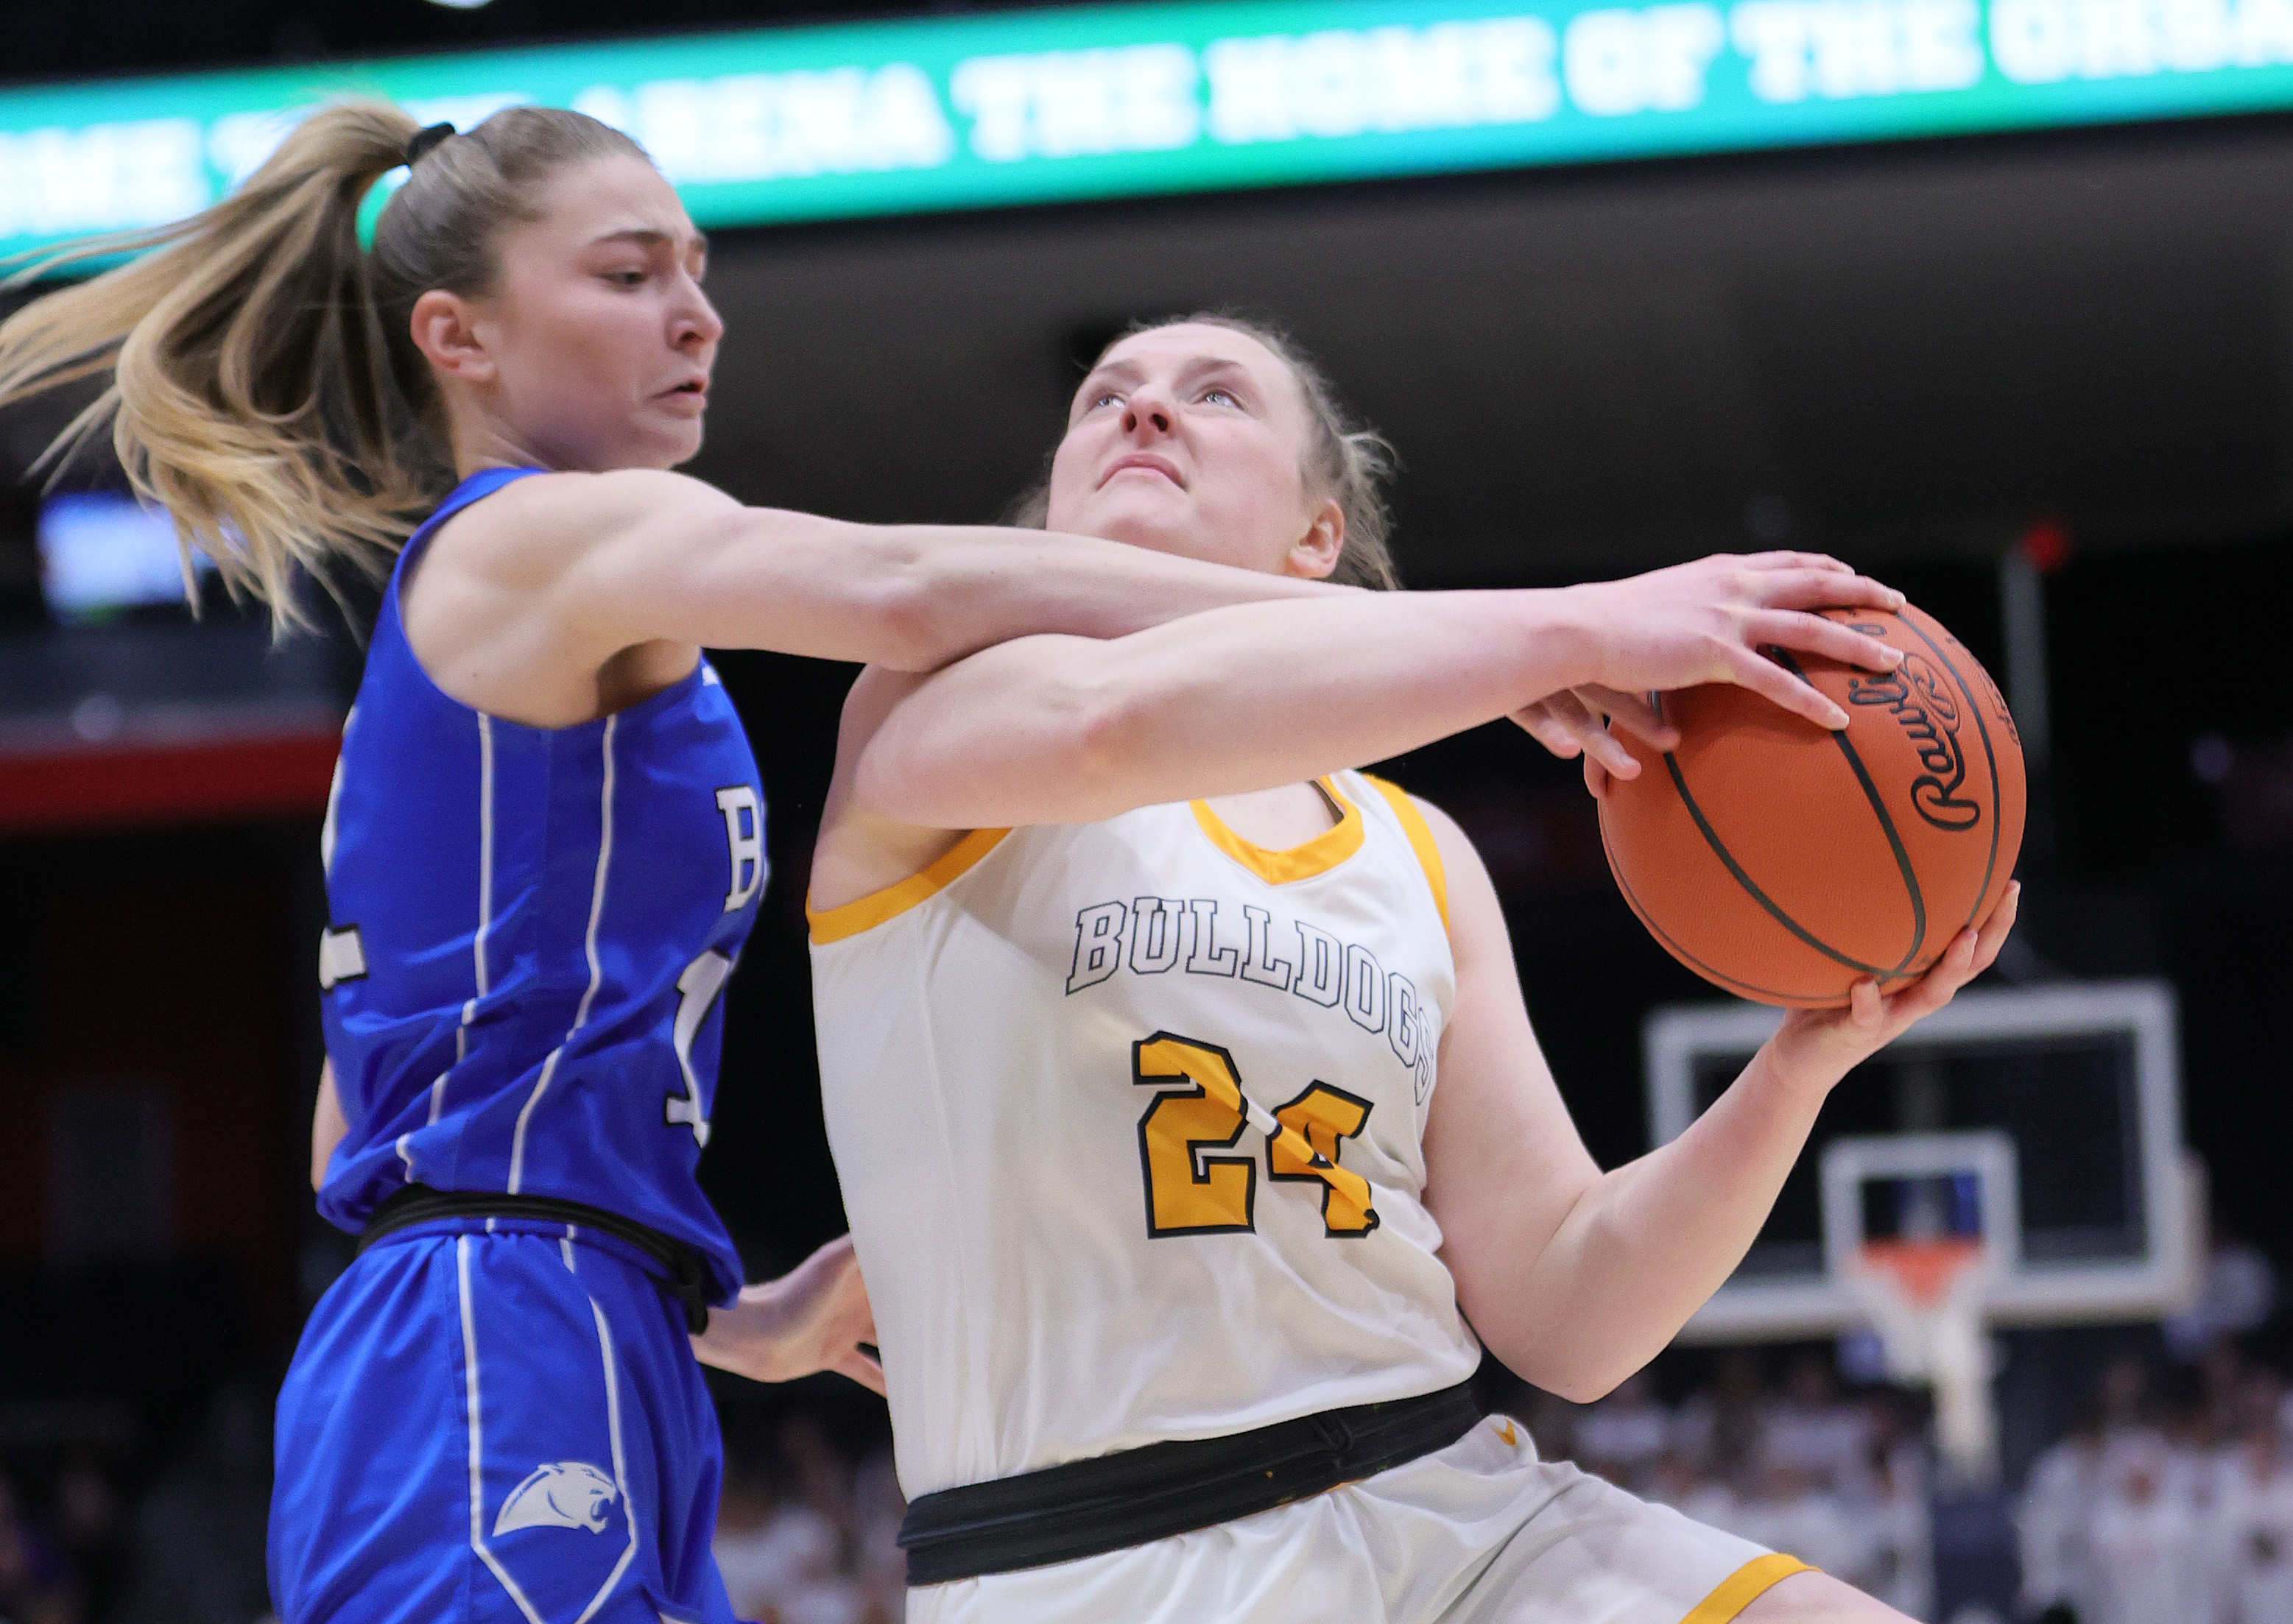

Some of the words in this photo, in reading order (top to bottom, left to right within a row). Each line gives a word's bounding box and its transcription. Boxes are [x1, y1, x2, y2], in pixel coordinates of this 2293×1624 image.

[954, 46, 1197, 160] THE
[1208, 18, 1557, 141] HOME
[1566, 6, 1723, 115] OF
[1732, 0, 1982, 102] THE
[1847, 608, 1981, 831] Rawli
[1066, 896, 1436, 1106] BULLDOGS
[1132, 1030, 1380, 1240] 24
